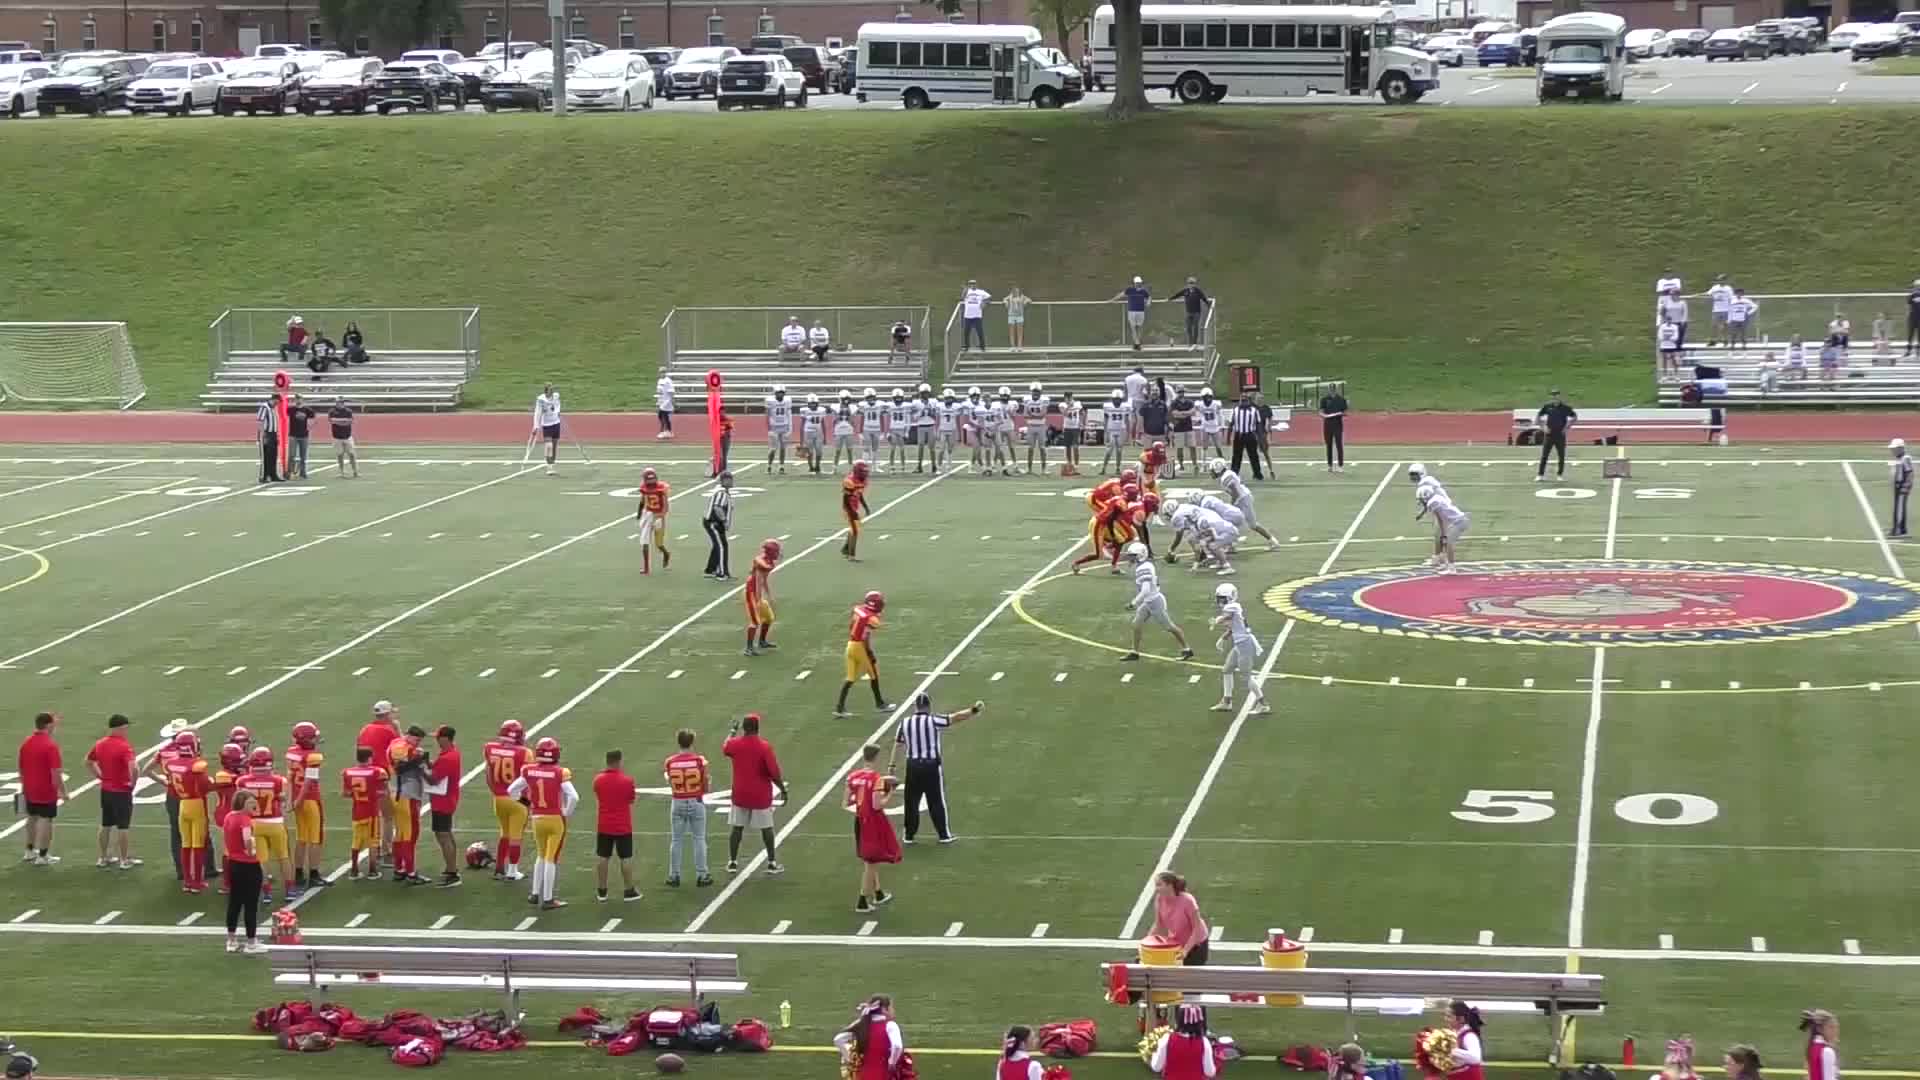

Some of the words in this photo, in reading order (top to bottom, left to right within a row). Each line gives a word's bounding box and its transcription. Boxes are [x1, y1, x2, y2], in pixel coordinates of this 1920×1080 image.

[490, 755, 515, 784] 78
[669, 767, 702, 794] 22
[535, 778, 548, 809] 1
